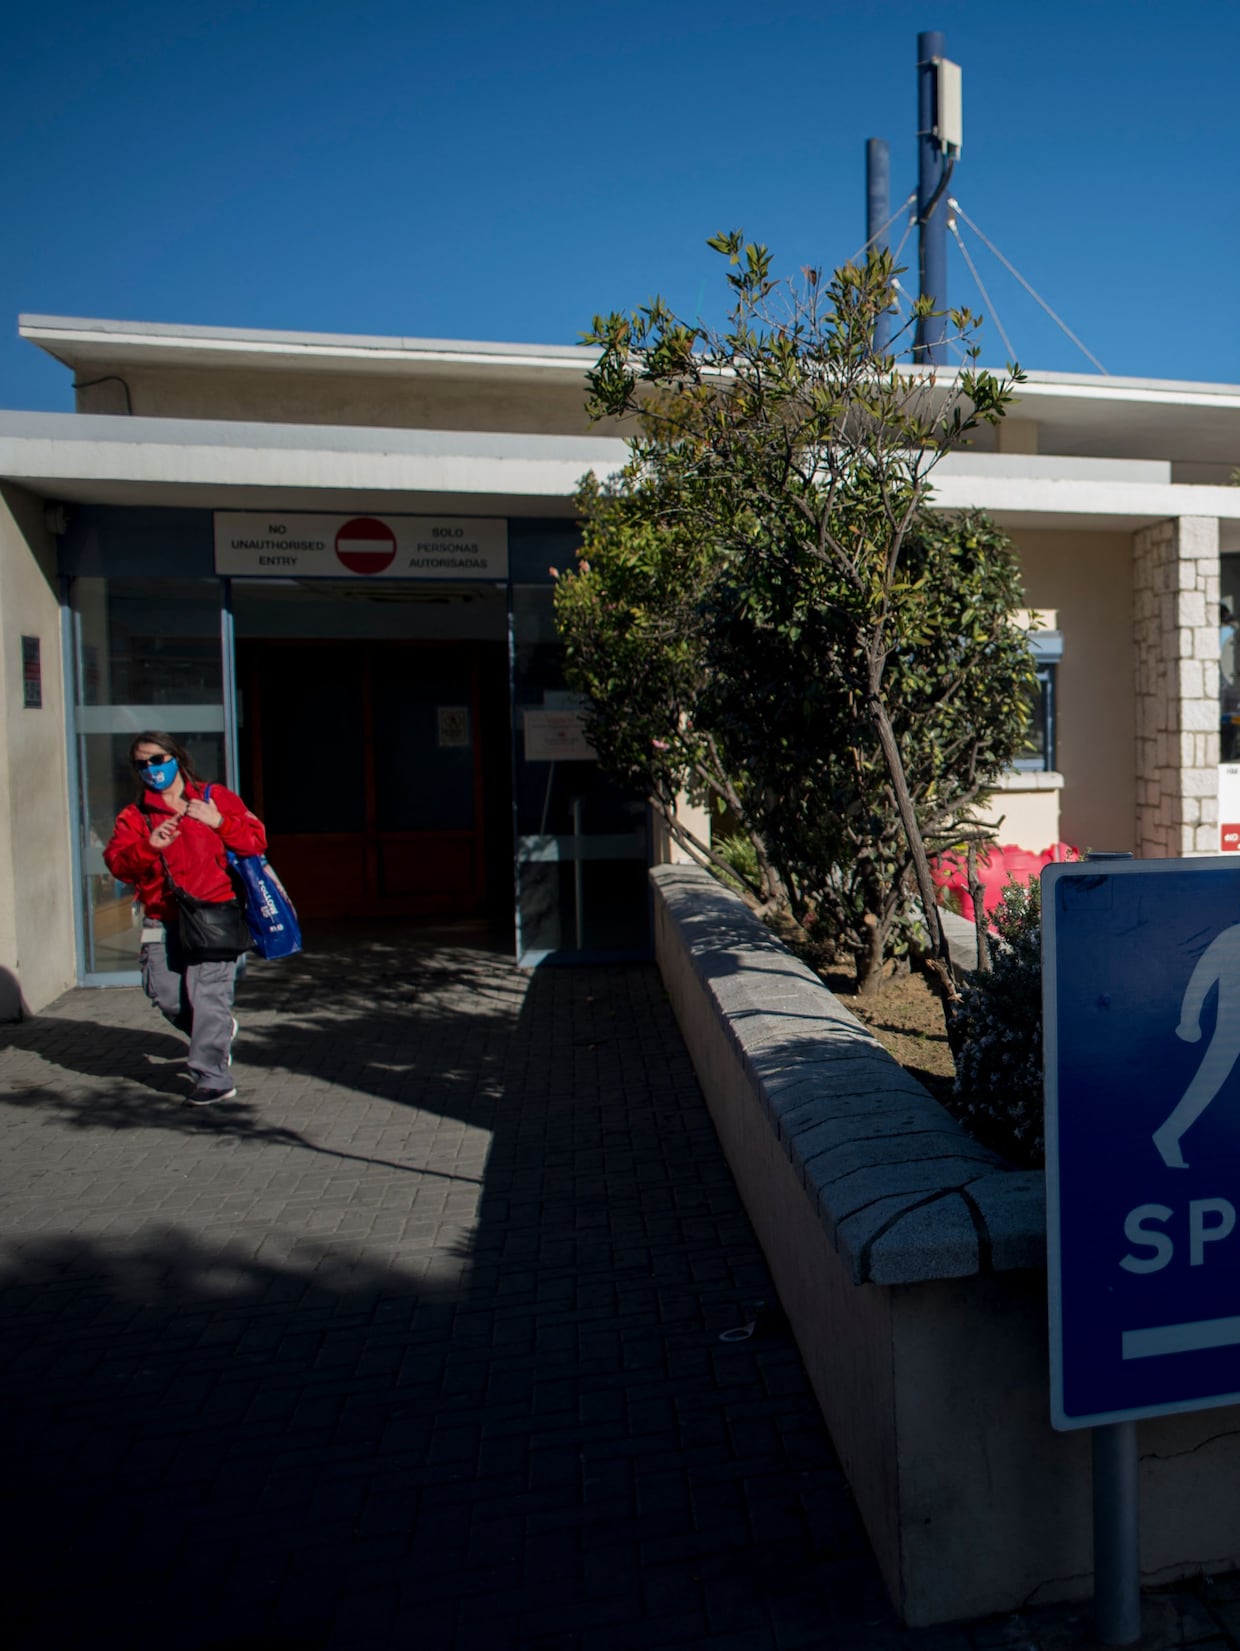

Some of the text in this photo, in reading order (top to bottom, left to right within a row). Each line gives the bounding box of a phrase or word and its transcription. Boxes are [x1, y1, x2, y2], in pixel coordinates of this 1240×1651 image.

[268, 524, 287, 535] NO
[431, 527, 464, 539] SOLO
[231, 540, 325, 551] UNAUTHORISED
[416, 542, 479, 554] PERSONAS
[258, 556, 297, 567] ENTRY
[409, 557, 488, 569] AUTORISADAS
